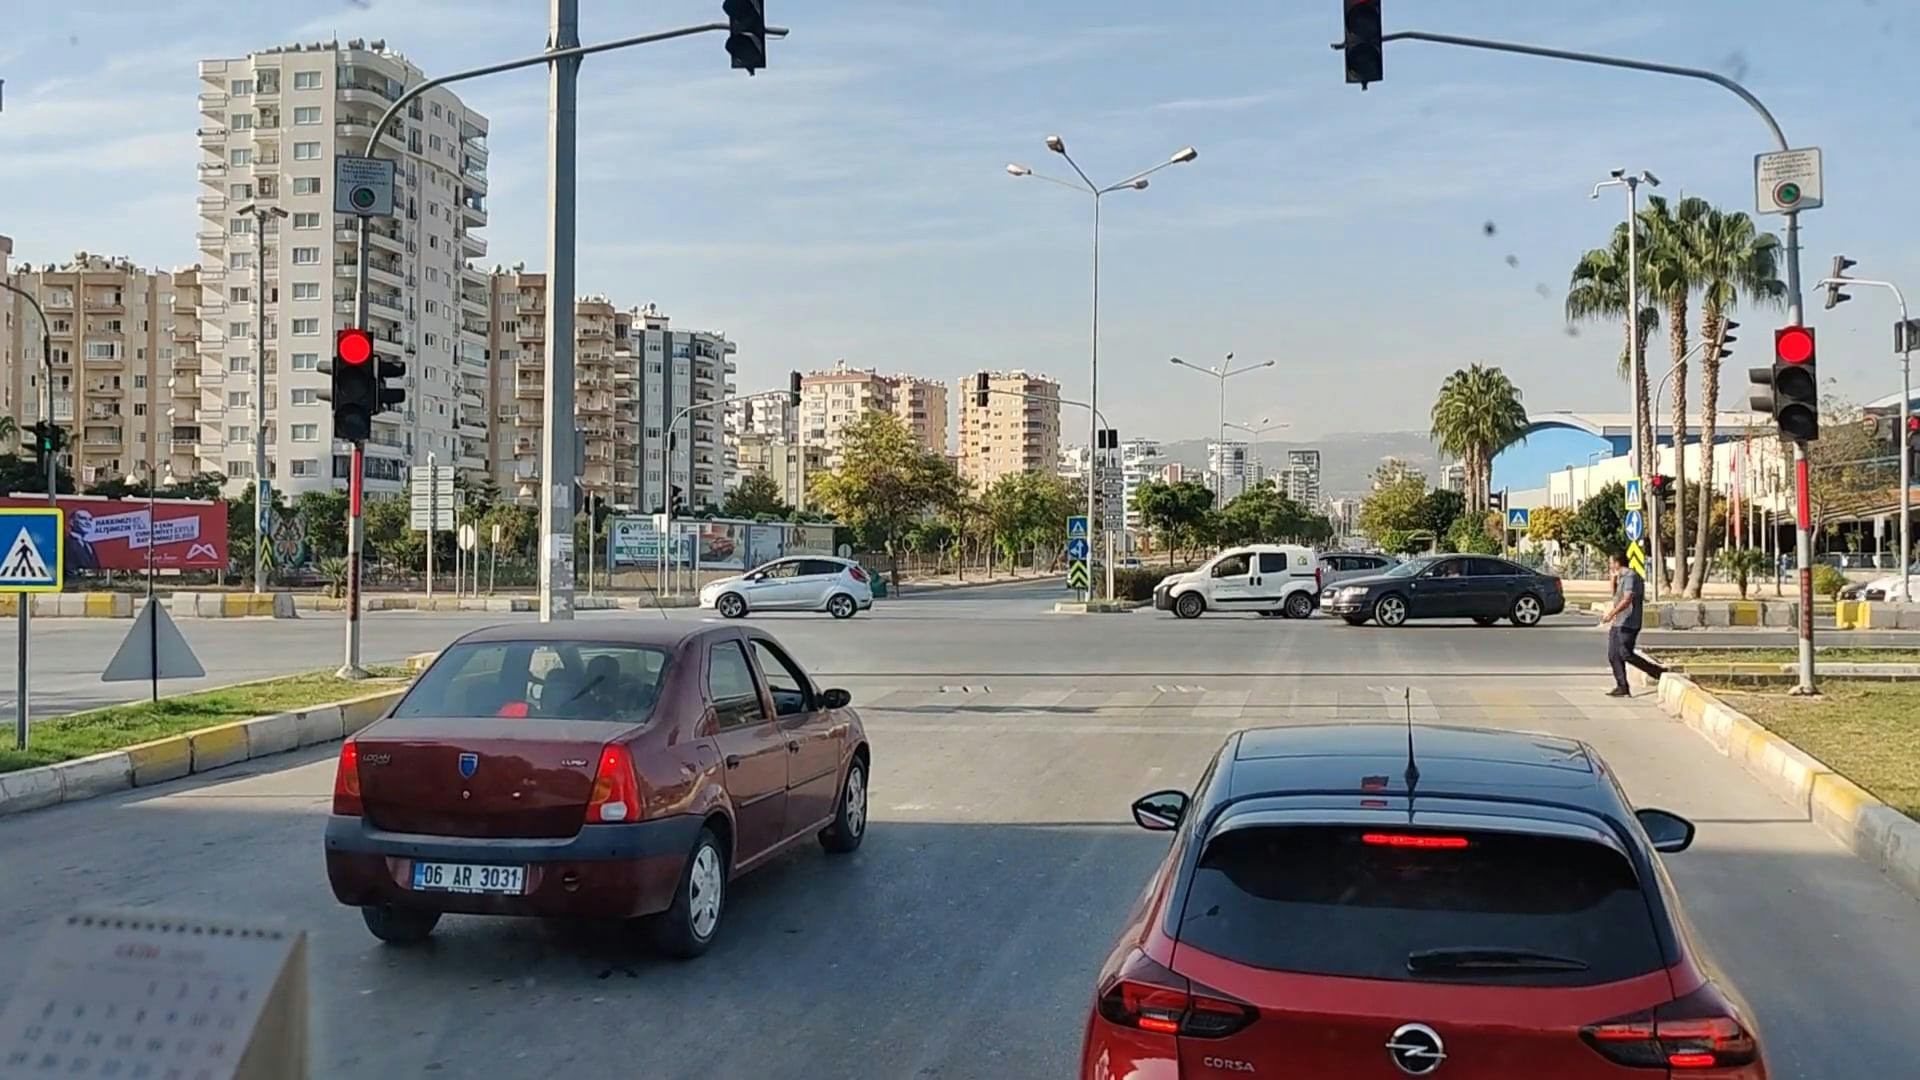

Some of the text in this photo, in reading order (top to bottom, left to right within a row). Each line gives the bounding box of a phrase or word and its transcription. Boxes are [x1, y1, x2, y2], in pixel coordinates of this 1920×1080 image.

[424, 865, 518, 888] 06 AR 3031
[1203, 1056, 1255, 1072] CORSA
